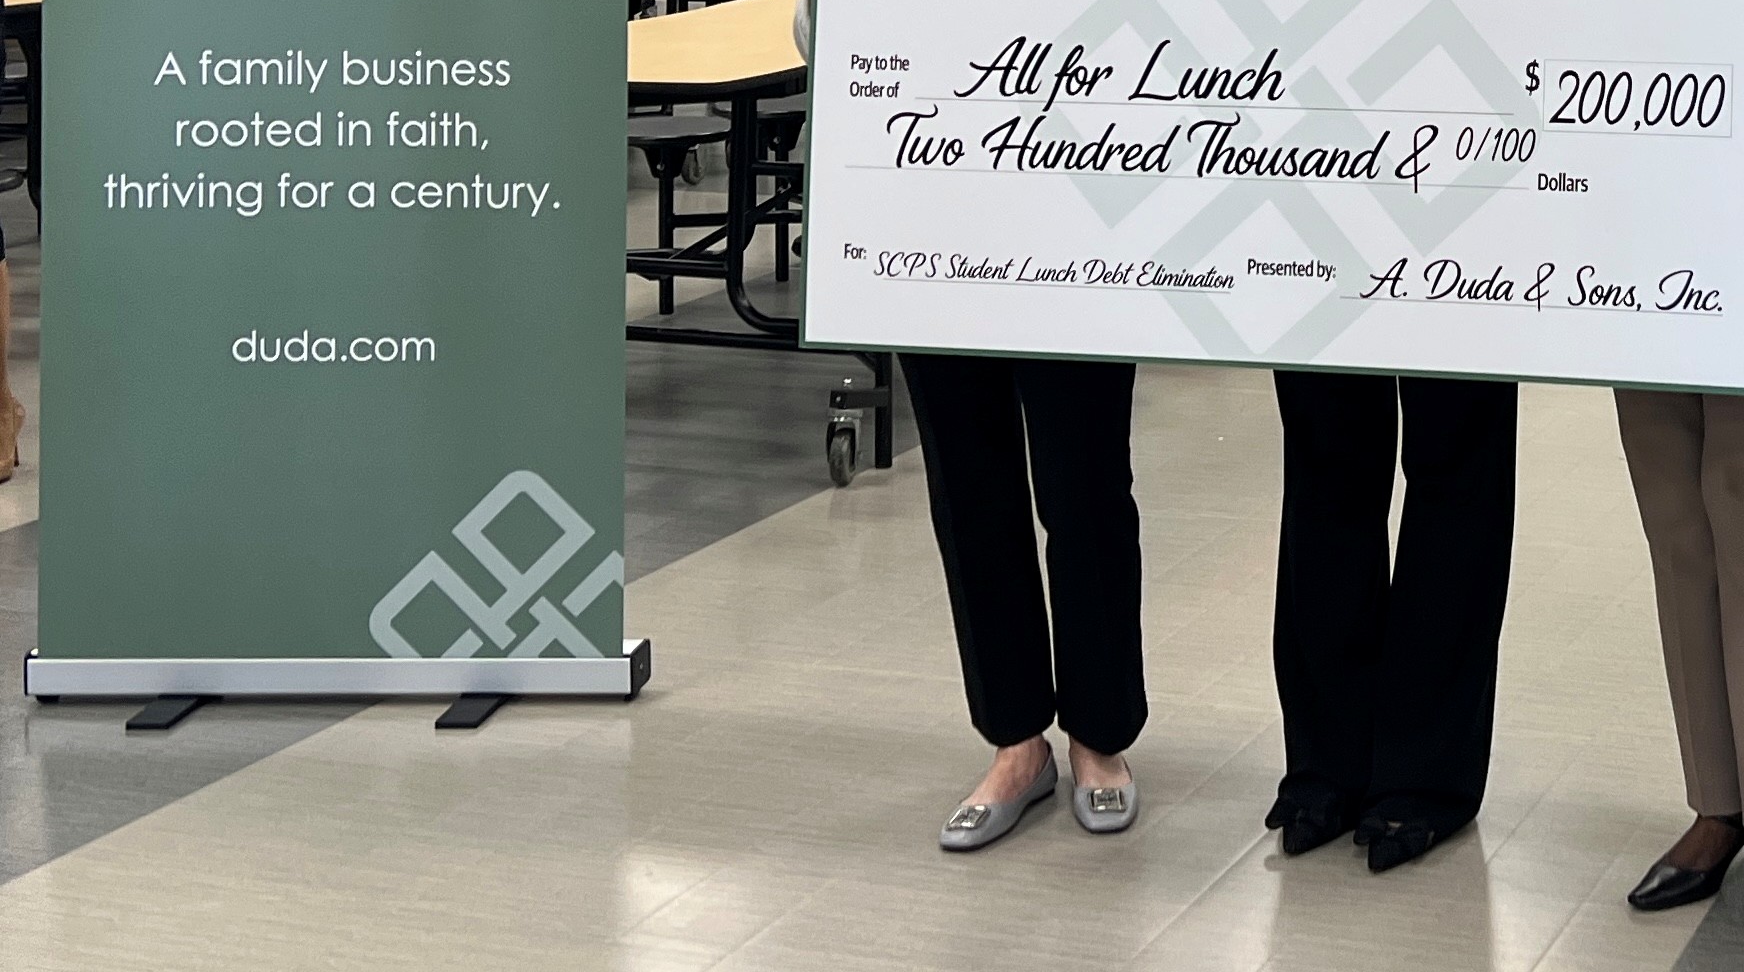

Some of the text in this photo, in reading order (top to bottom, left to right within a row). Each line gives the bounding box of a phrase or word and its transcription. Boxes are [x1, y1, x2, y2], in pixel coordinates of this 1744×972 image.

[153, 49, 512, 95] A family business
[850, 53, 910, 73] Pay to the
[953, 36, 1286, 114] All for Lunch
[849, 81, 900, 99] Order of
[1524, 59, 1727, 132] $ 200,000
[176, 110, 490, 152] rooted in faith,
[886, 105, 1537, 194] Two Hundred Thousand & 0/100
[103, 172, 562, 219] thriving for a century.
[1537, 172, 1590, 194] Dollars
[843, 243, 868, 261] For:
[873, 251, 1236, 290] SCPS Student Lunch Debt Elimination
[1247, 257, 1337, 282] Presented by:
[1359, 257, 1725, 313] A. Duda & Sons, Inc.
[232, 328, 437, 363] duda.com
